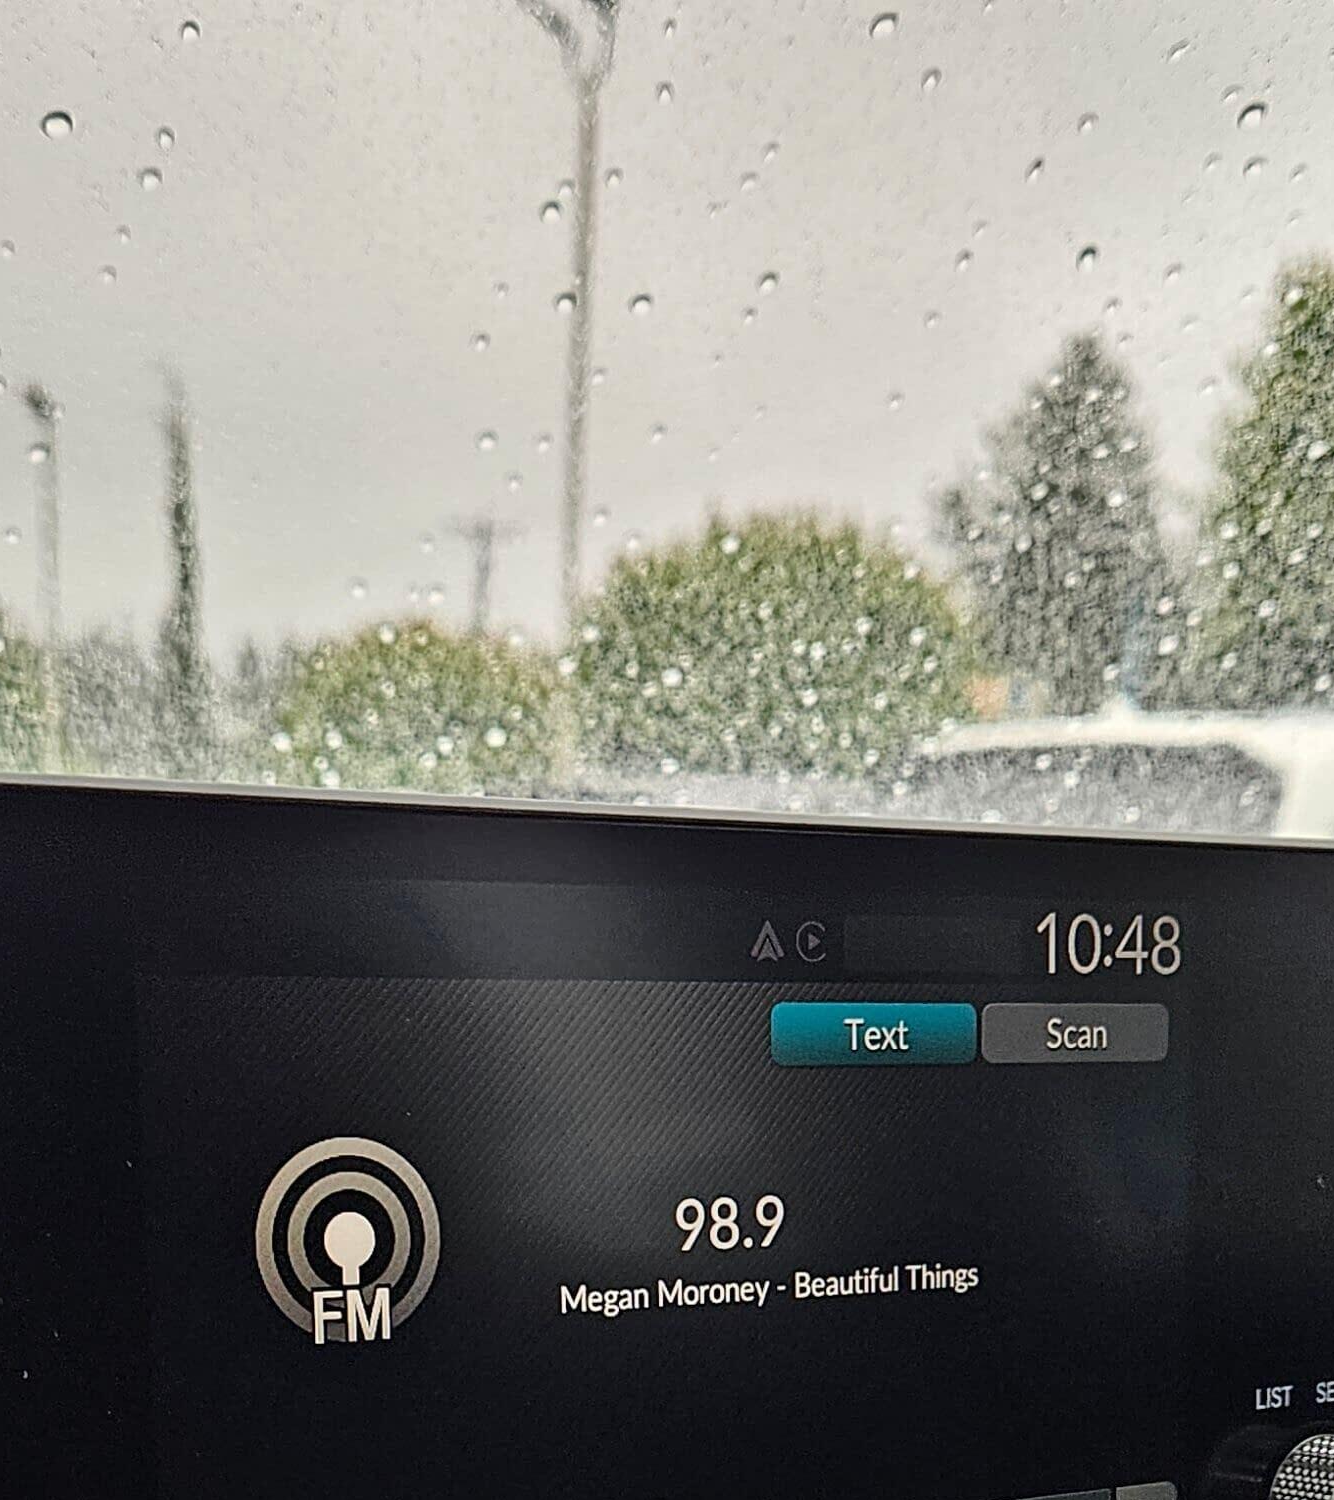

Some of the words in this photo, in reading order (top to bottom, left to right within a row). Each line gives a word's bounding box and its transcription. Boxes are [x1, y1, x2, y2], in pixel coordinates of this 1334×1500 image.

[1035, 911, 1182, 976] 10:48
[843, 1017, 910, 1052] Text
[1045, 1016, 1109, 1051] Scan
[675, 1194, 785, 1252] 98.9
[312, 1285, 392, 1345] FM
[559, 1284, 650, 1318] Megan
[657, 1277, 770, 1307] Moroney
[793, 1265, 899, 1299] Beautiful
[905, 1263, 980, 1295] Things
[1255, 1385, 1294, 1411] LIST
